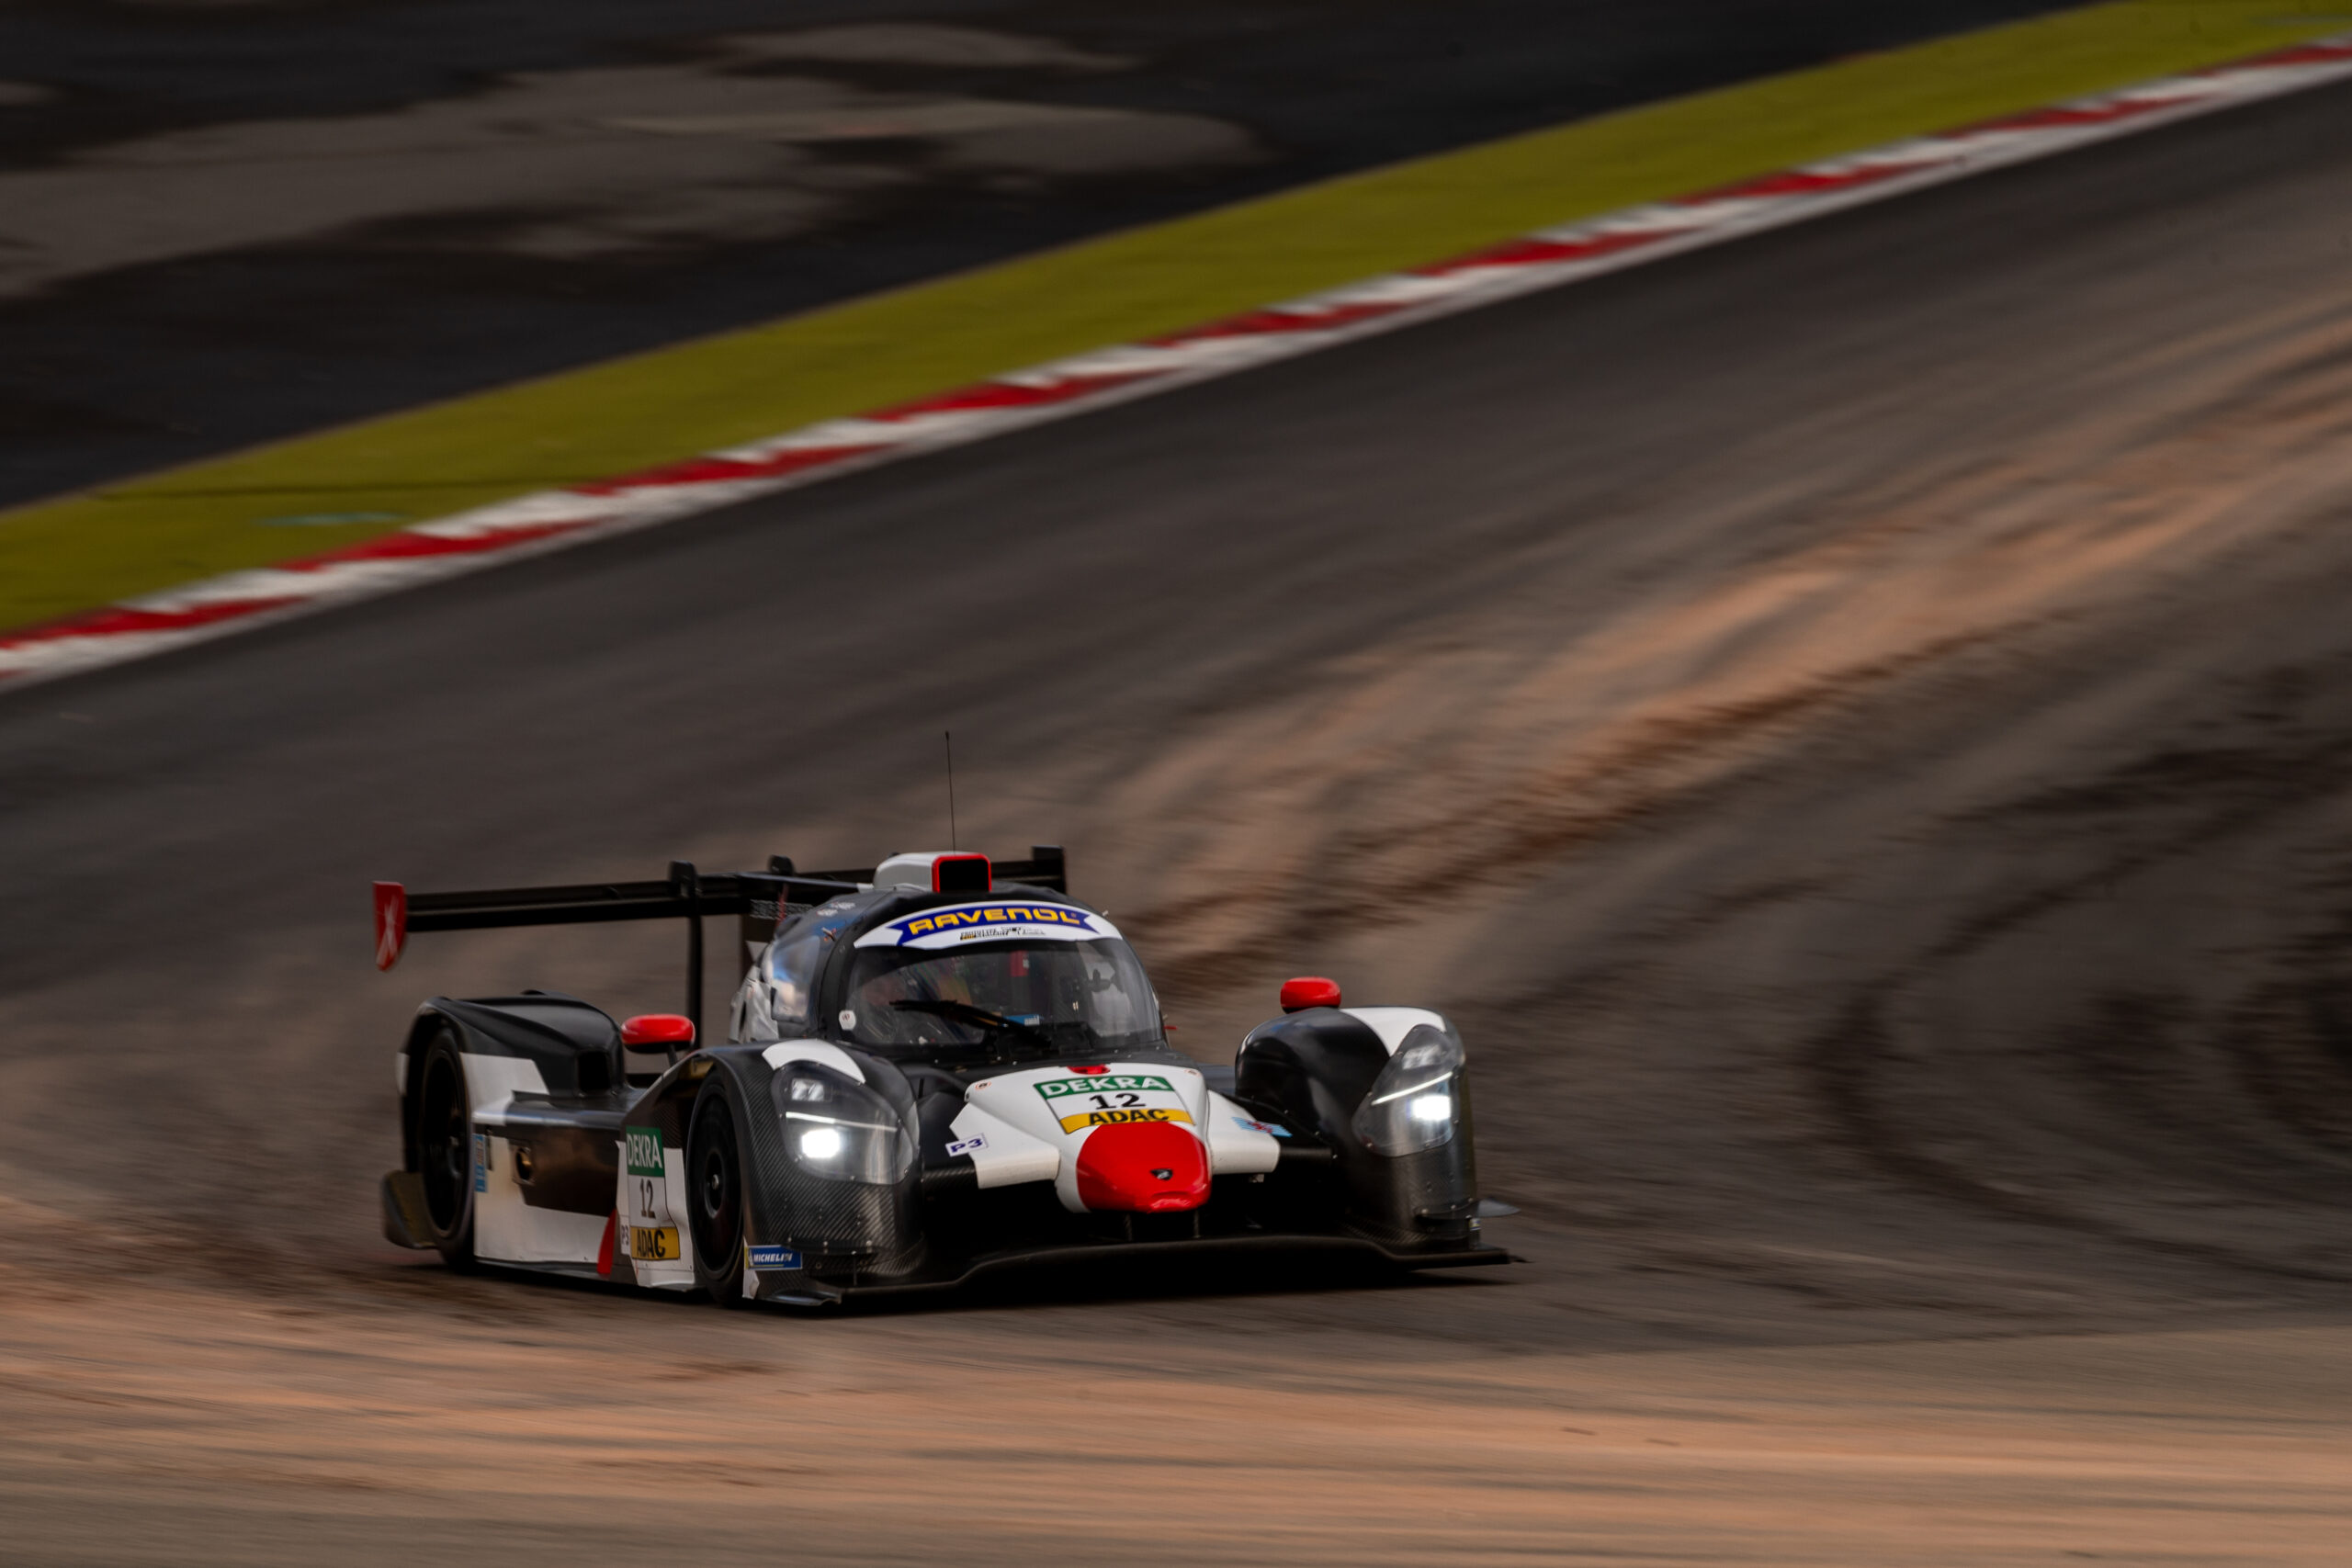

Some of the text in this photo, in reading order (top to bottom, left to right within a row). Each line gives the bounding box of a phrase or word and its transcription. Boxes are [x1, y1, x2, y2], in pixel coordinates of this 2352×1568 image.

[908, 908, 1080, 935] RAVENOL
[1040, 1077, 1170, 1097] DEKRA
[1089, 1093, 1146, 1110] 12
[1089, 1109, 1170, 1125] ADAC
[627, 1134, 662, 1168] DEKRA
[950, 1138, 983, 1153] P3
[639, 1178, 655, 1219] 12
[637, 1229, 665, 1258] ADAC
[753, 1252, 793, 1263] MICHELIN
